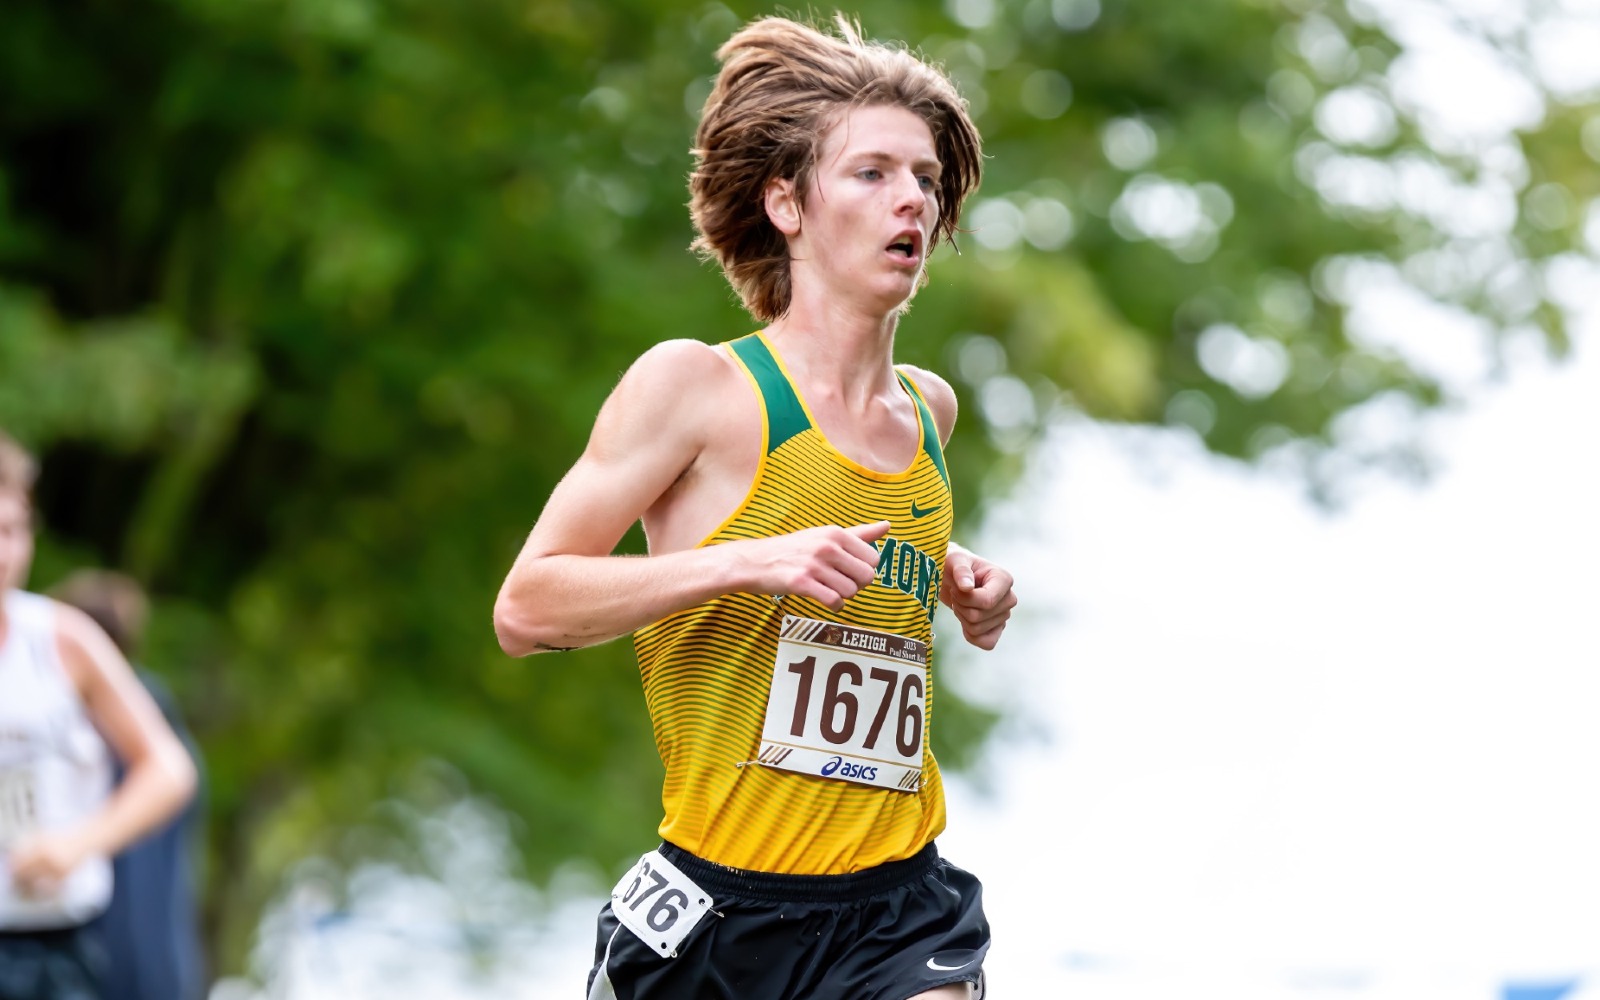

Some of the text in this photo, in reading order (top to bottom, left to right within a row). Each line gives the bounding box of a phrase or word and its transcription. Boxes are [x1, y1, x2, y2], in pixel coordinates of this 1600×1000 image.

[842, 631, 887, 651] LEHIGH
[903, 640, 917, 651] 2023
[889, 647, 902, 658] Paul
[902, 650, 916, 660] Short
[788, 655, 923, 758] 1676
